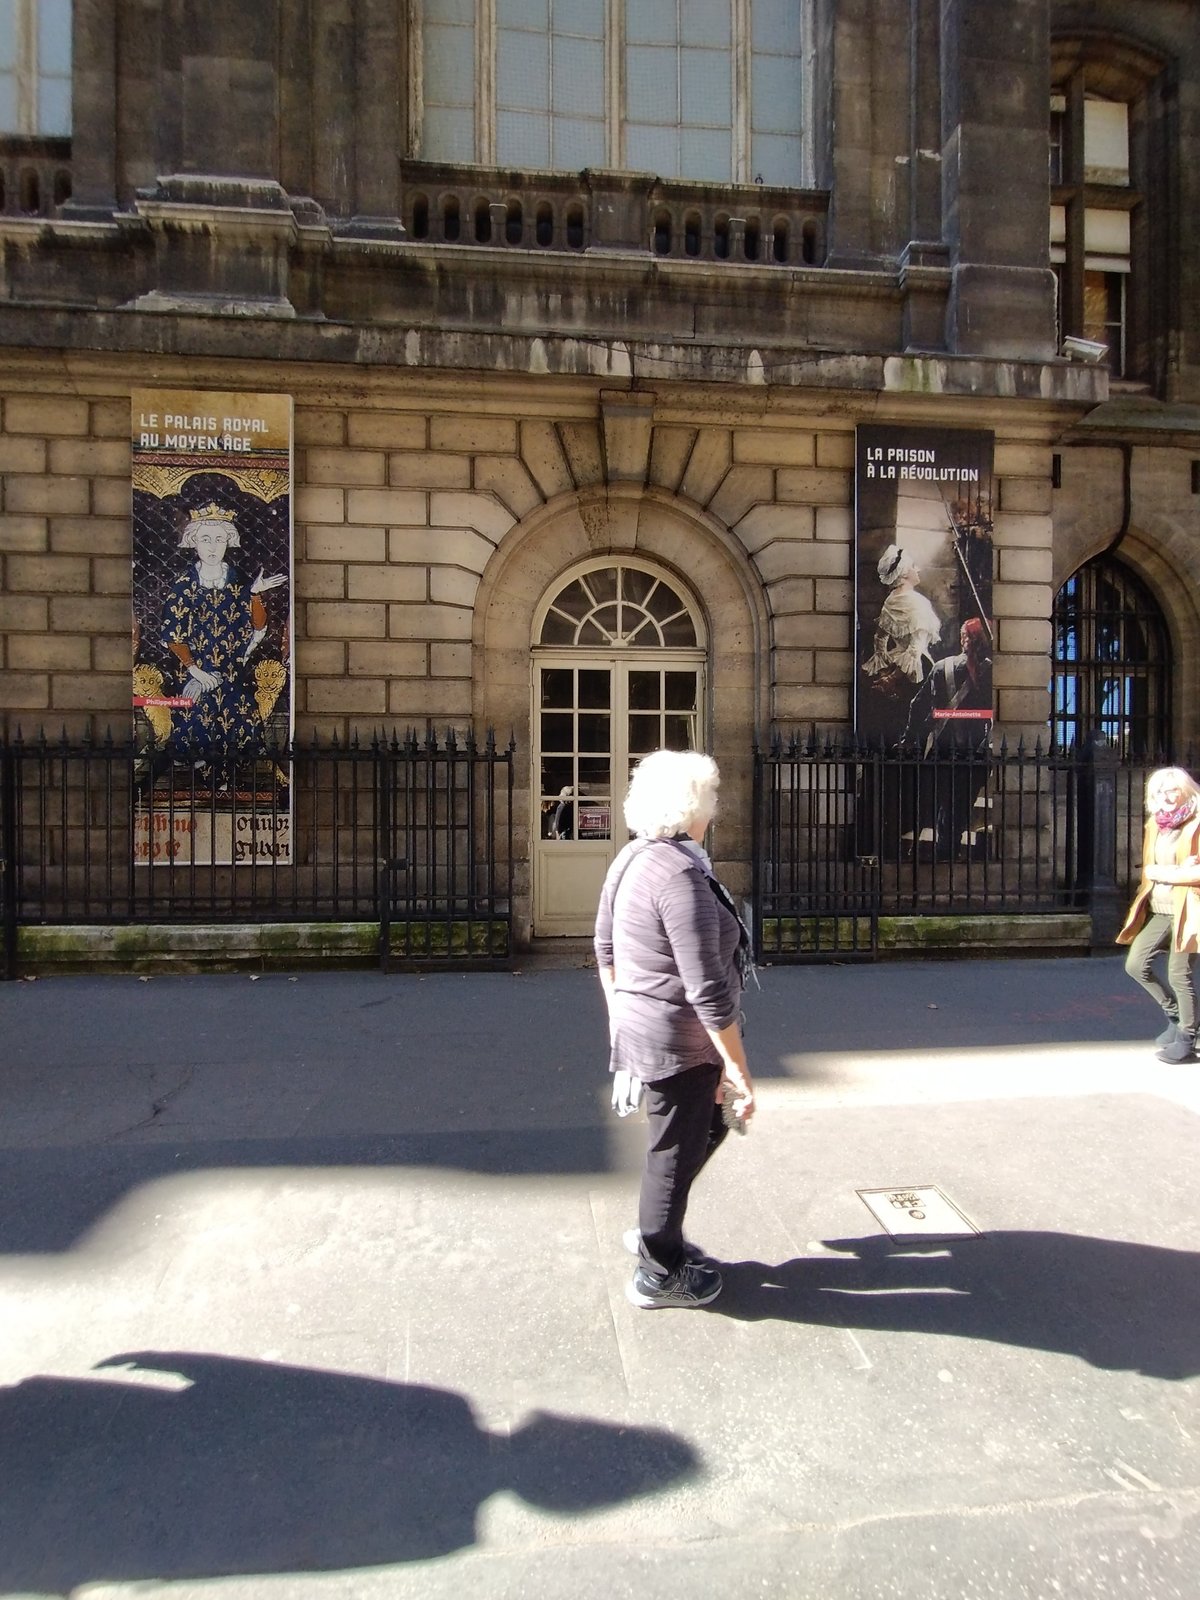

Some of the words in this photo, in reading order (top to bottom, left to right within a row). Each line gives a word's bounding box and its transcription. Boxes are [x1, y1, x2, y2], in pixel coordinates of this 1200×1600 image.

[140, 413, 158, 428] LE
[164, 414, 217, 431] PALAIS
[223, 418, 269, 433] ROYAL
[140, 433, 159, 447] AU
[165, 434, 218, 450] MOYEN
[223, 433, 251, 452] ÂGE
[867, 447, 883, 461] LA
[887, 448, 935, 463] PRISON
[867, 462, 875, 479] À
[880, 465, 896, 479] LA
[900, 464, 979, 482] RÉVOLUTION
[146, 698, 171, 706] Philippe
